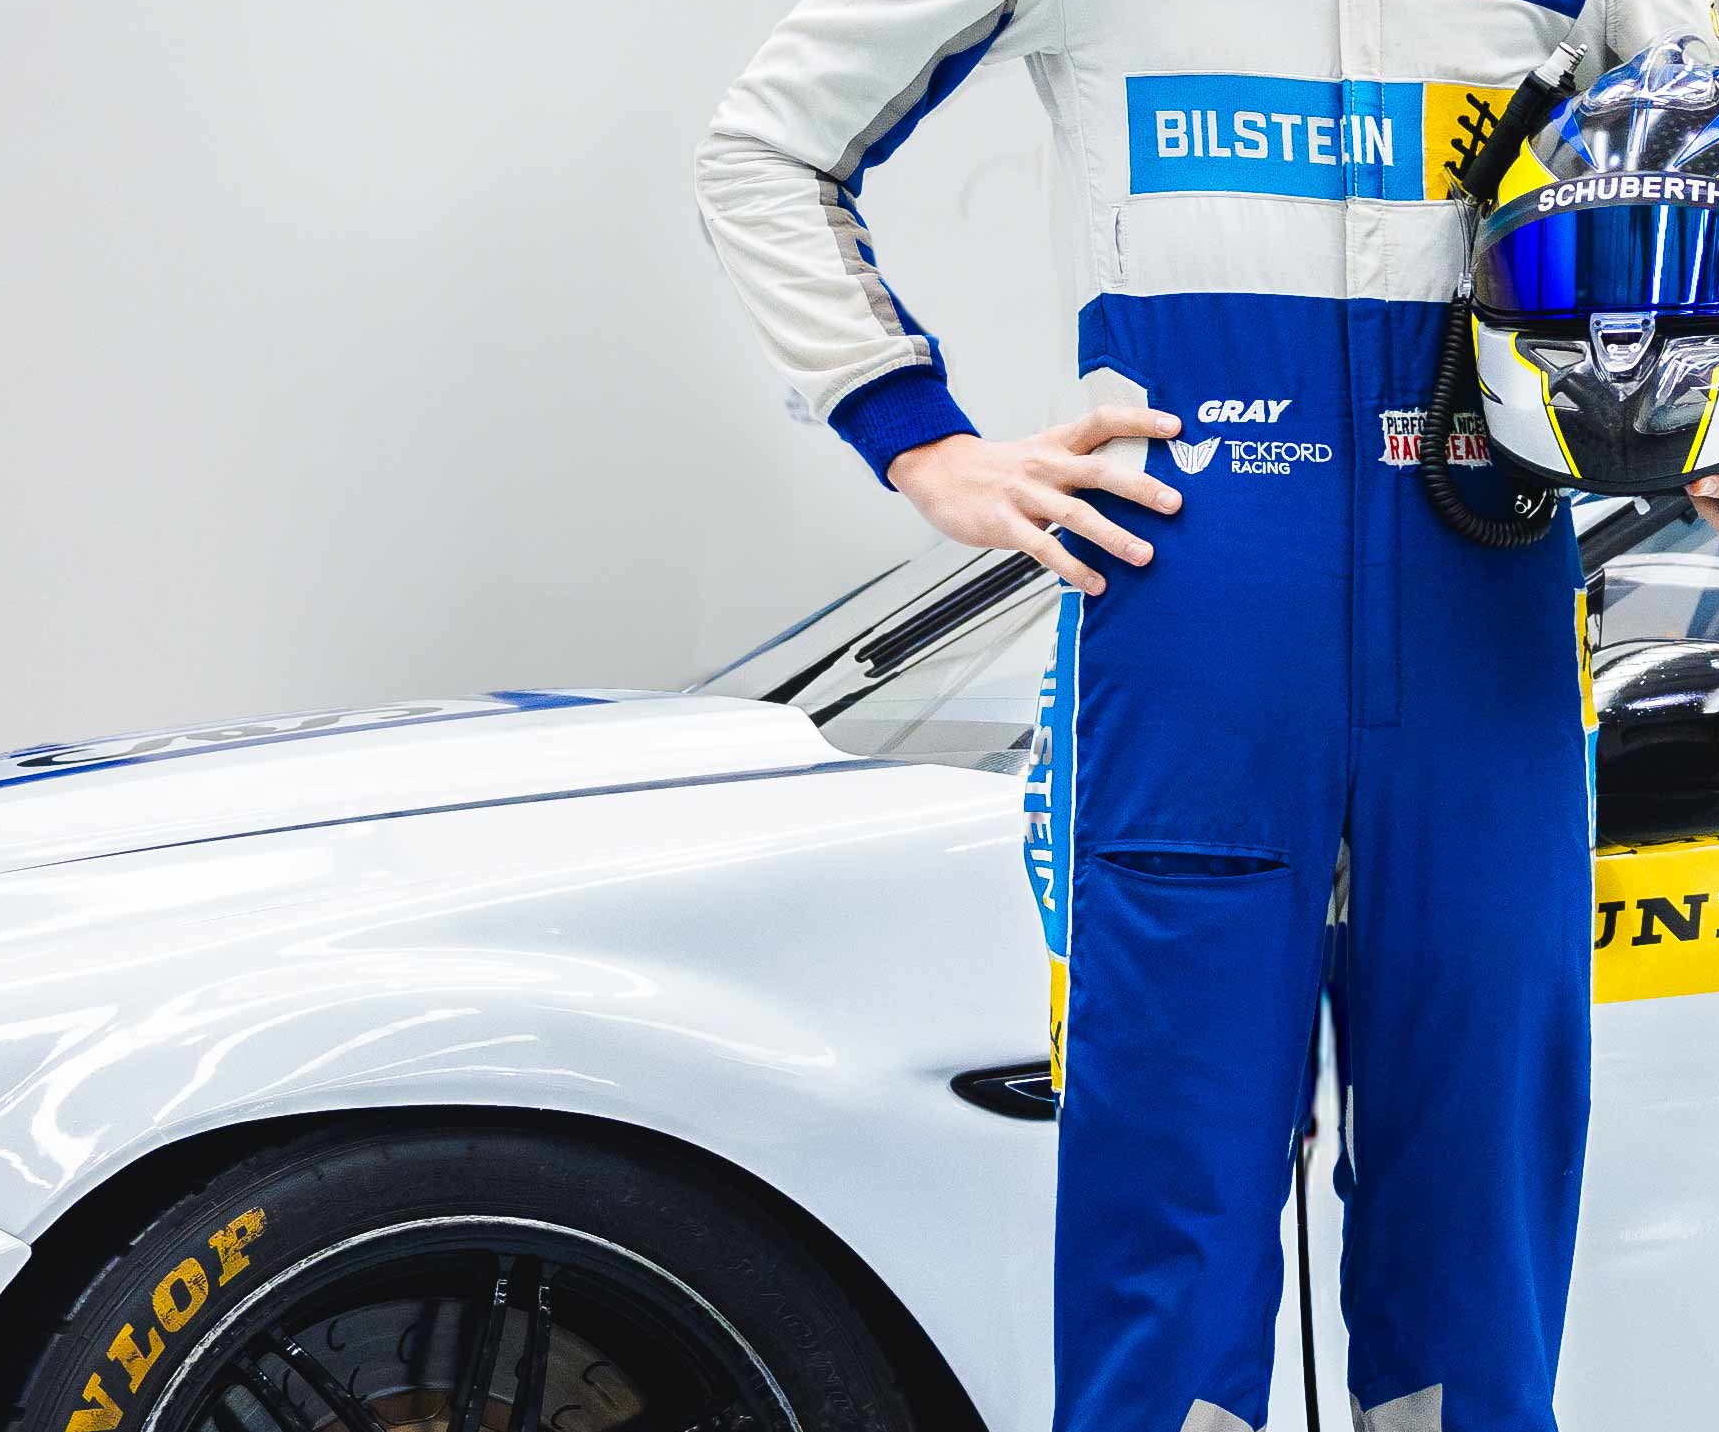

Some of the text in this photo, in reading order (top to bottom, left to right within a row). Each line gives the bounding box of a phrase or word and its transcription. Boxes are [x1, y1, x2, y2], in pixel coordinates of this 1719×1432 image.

[1156, 110, 1394, 167] BILSTEIN
[1197, 399, 1293, 423] GRAY
[1224, 440, 1333, 463] TICKFORD
[1231, 461, 1291, 475] RACING
